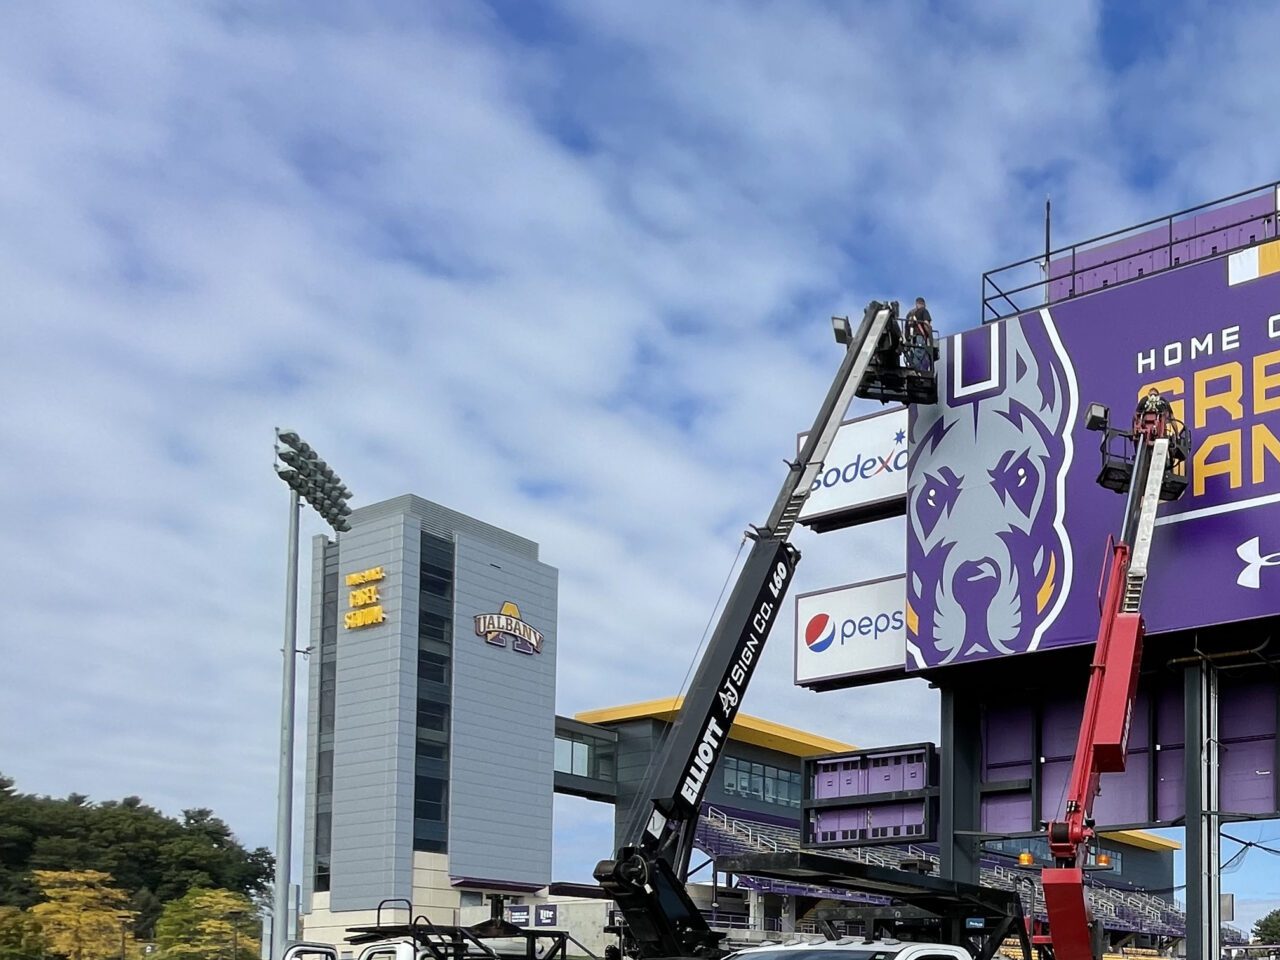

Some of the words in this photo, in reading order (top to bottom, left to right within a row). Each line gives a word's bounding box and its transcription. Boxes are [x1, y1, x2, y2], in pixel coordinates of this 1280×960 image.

[1137, 325, 1240, 374] HOME
[475, 614, 544, 653] UALBANY
[841, 610, 904, 646] peps
[680, 717, 724, 806] ELLIOTT
[731, 632, 760, 687] SIGN
[753, 601, 774, 635] CO.
[768, 562, 788, 599] L60
